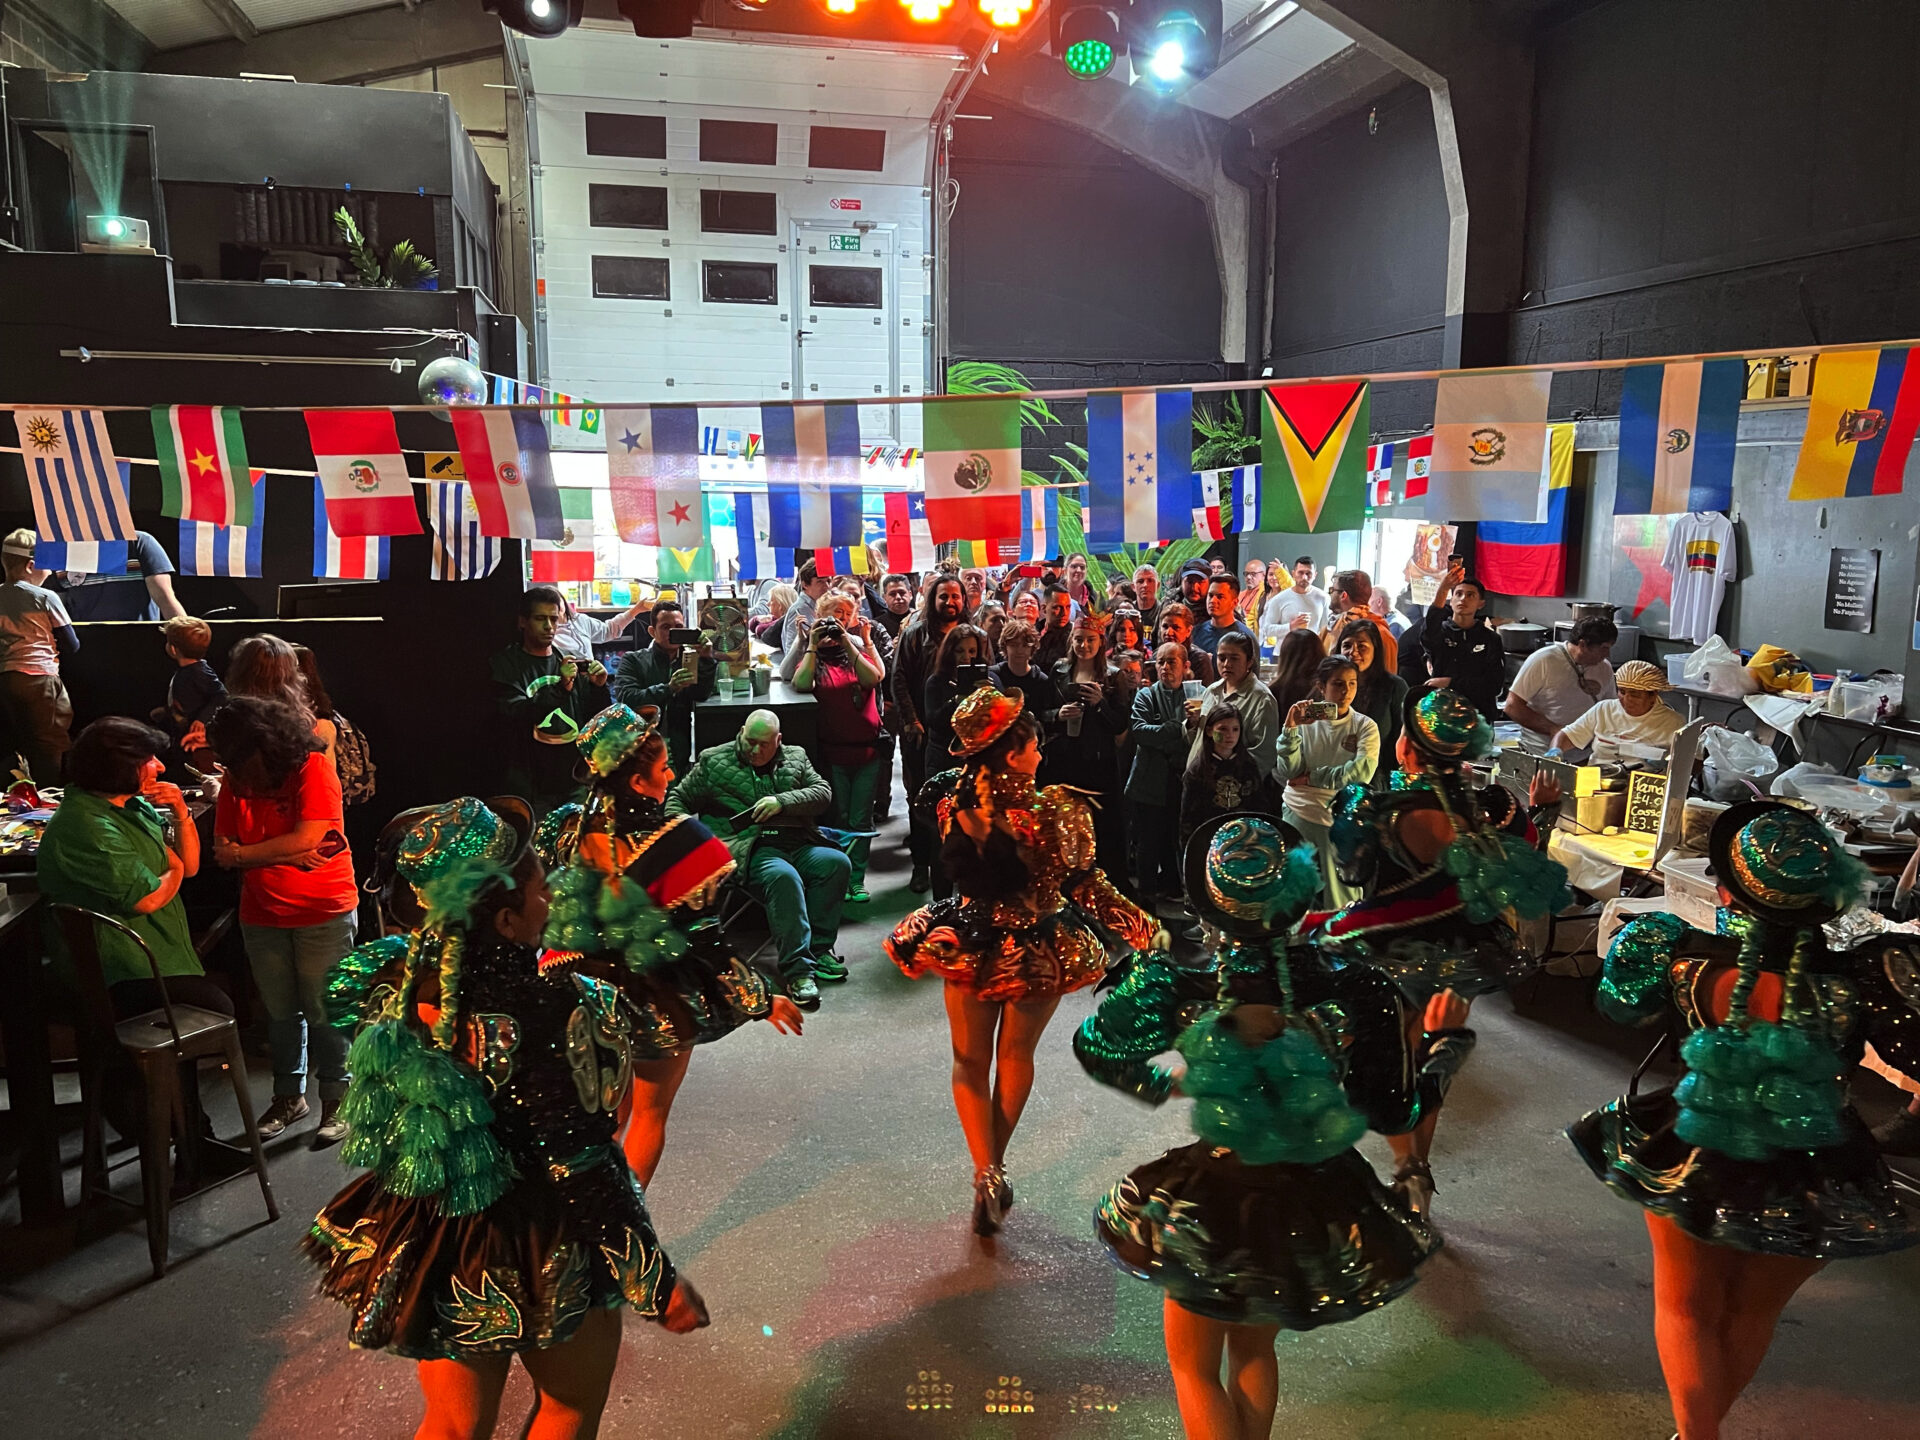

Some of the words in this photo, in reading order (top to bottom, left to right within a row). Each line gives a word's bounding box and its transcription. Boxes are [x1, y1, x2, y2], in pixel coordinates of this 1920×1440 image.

[1635, 776, 1664, 796] Tama
[1632, 792, 1662, 806] £4.0
[1628, 816, 1659, 831] £3.5
